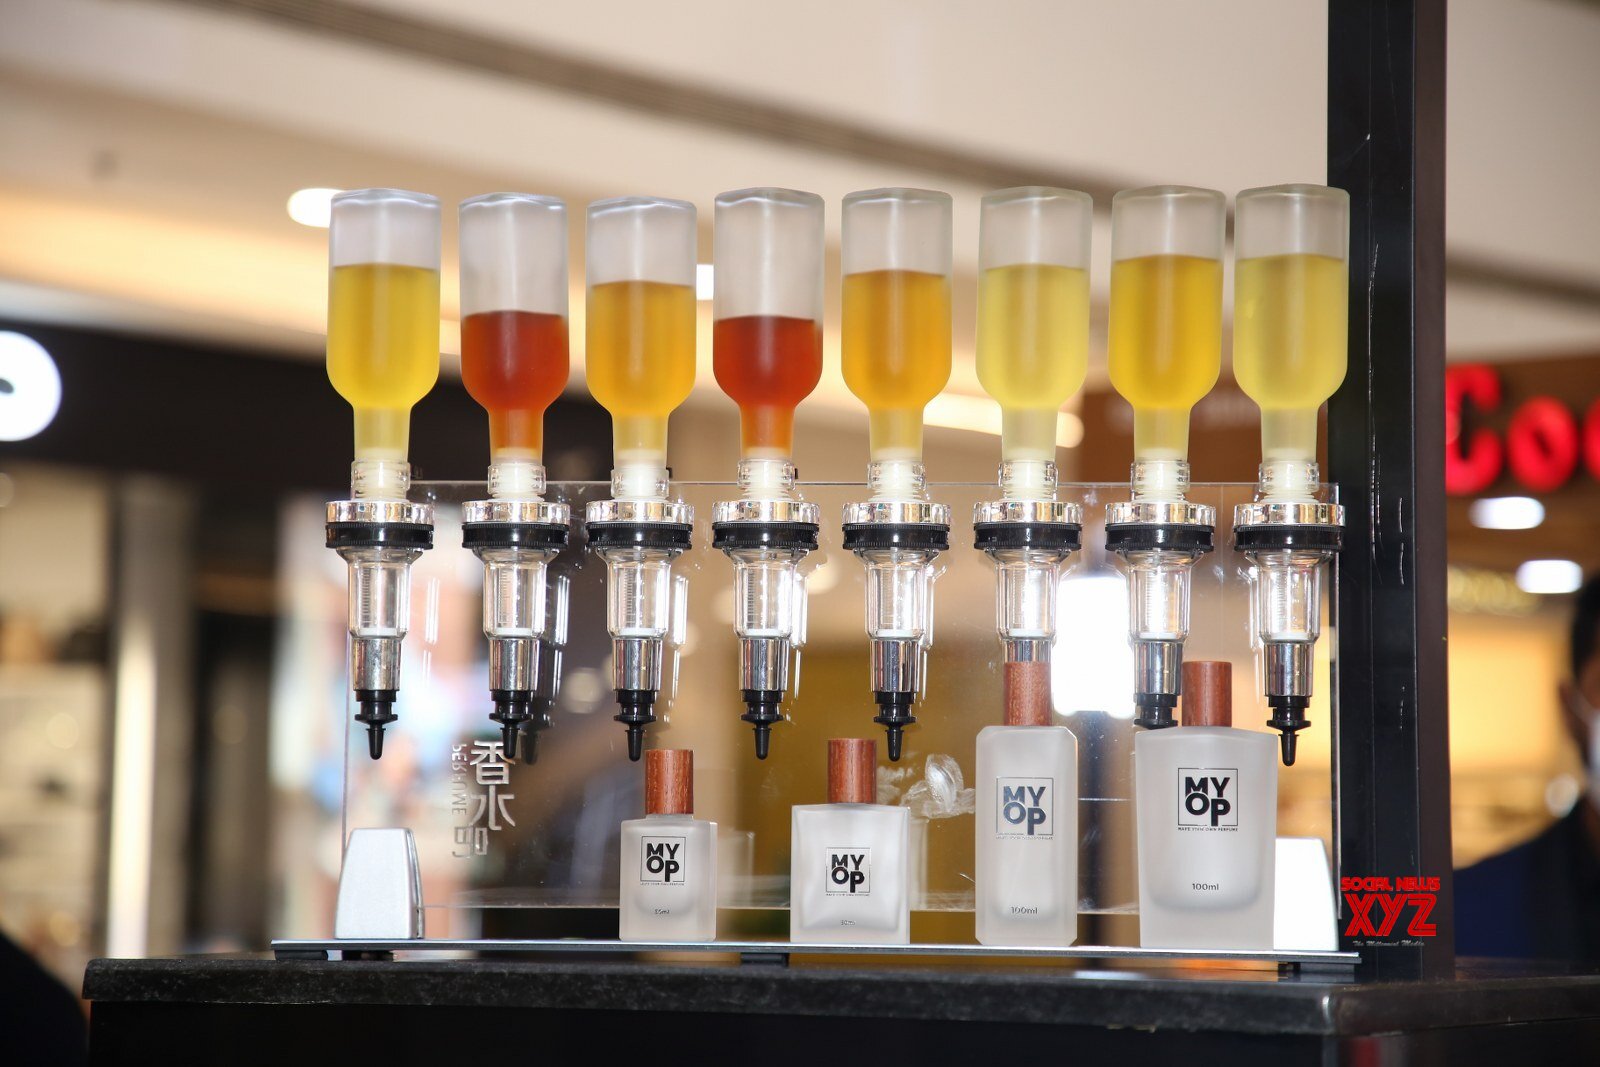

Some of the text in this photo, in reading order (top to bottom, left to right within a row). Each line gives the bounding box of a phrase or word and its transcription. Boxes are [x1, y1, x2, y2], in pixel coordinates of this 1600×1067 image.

[1445, 362, 1600, 493] Co
[1003, 785, 1046, 806] MY
[1185, 776, 1231, 798] MY
[1003, 802, 1046, 836] OP
[1185, 792, 1231, 826] OP
[646, 843, 680, 859] MY
[831, 854, 865, 870] MY
[646, 855, 680, 882] OP
[831, 867, 865, 893] OP
[1192, 883, 1219, 891] 100ml
[1011, 906, 1038, 915] 100ml
